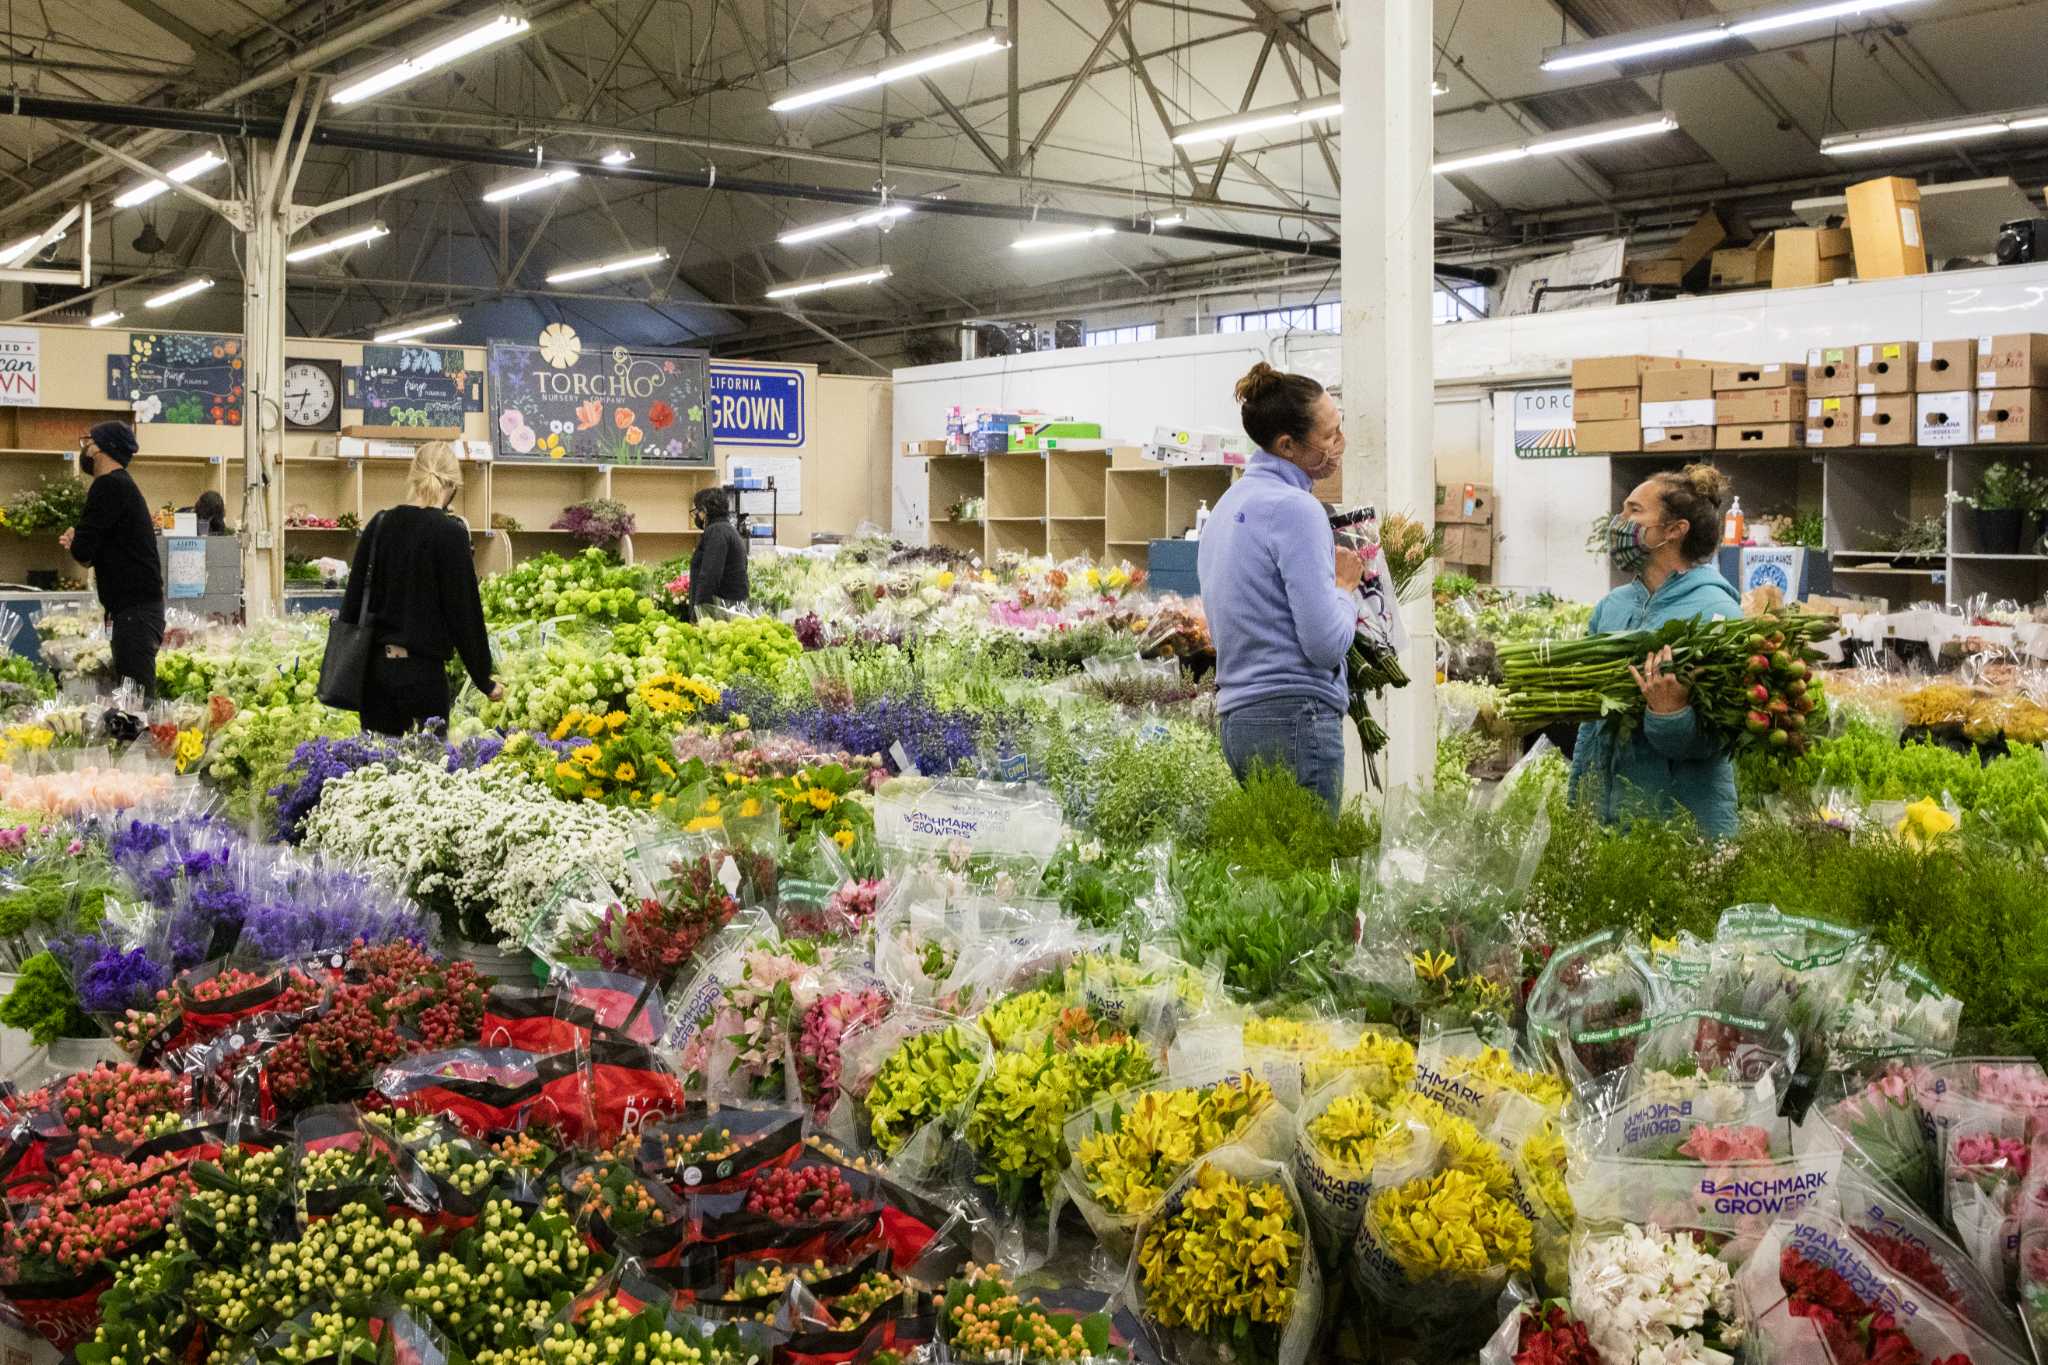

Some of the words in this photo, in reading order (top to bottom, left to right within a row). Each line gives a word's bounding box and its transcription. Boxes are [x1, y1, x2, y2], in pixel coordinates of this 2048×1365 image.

[710, 376, 761, 391] LIFORNIA
[711, 395, 784, 430] GROWN
[1520, 447, 1562, 457] NURSERY
